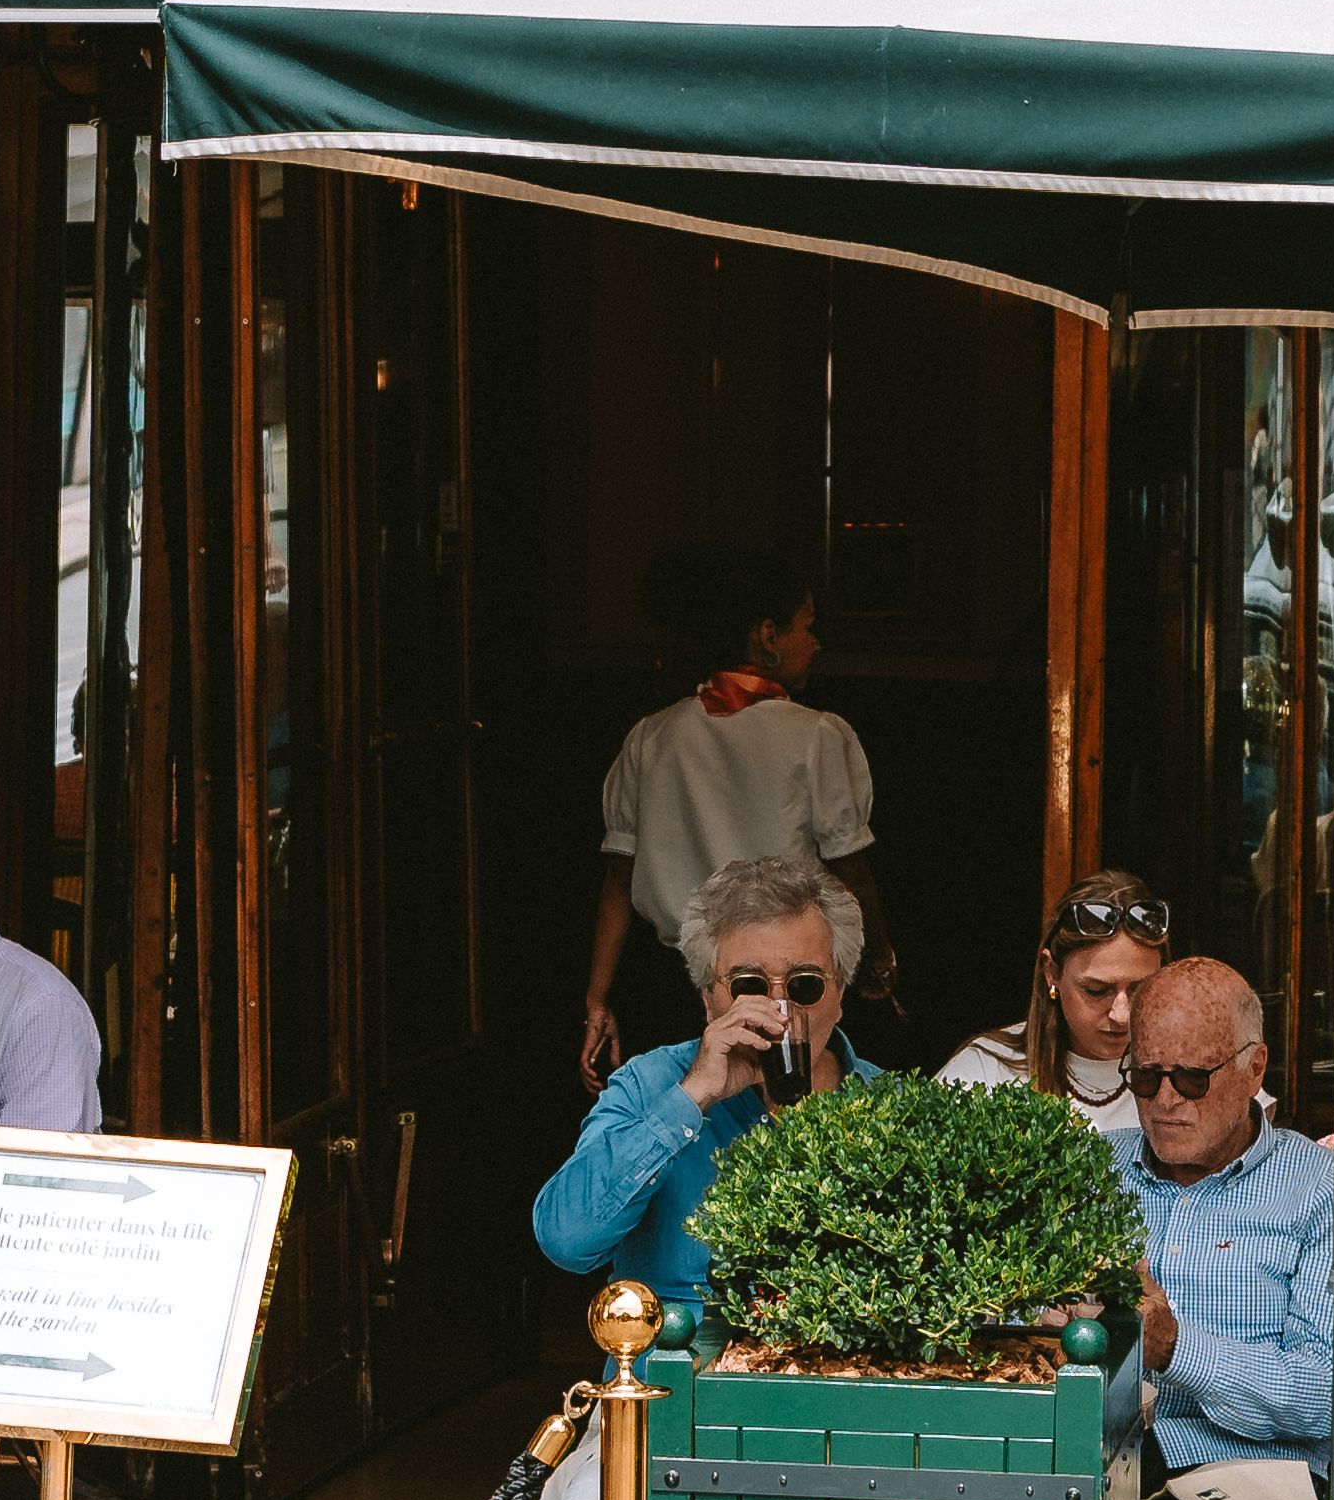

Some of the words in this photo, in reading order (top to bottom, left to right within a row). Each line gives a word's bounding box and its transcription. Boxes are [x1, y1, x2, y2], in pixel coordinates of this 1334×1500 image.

[18, 1210, 106, 1232] patienter
[110, 1216, 155, 1237] dans
[161, 1220, 178, 1238] la
[182, 1222, 214, 1241] file
[58, 1235, 99, 1256] côté
[102, 1241, 161, 1263] jardin
[42, 1288, 62, 1306] in
[66, 1289, 103, 1310] line
[107, 1293, 175, 1315] besides
[0, 1310, 29, 1328] the
[29, 1314, 98, 1335] garden
